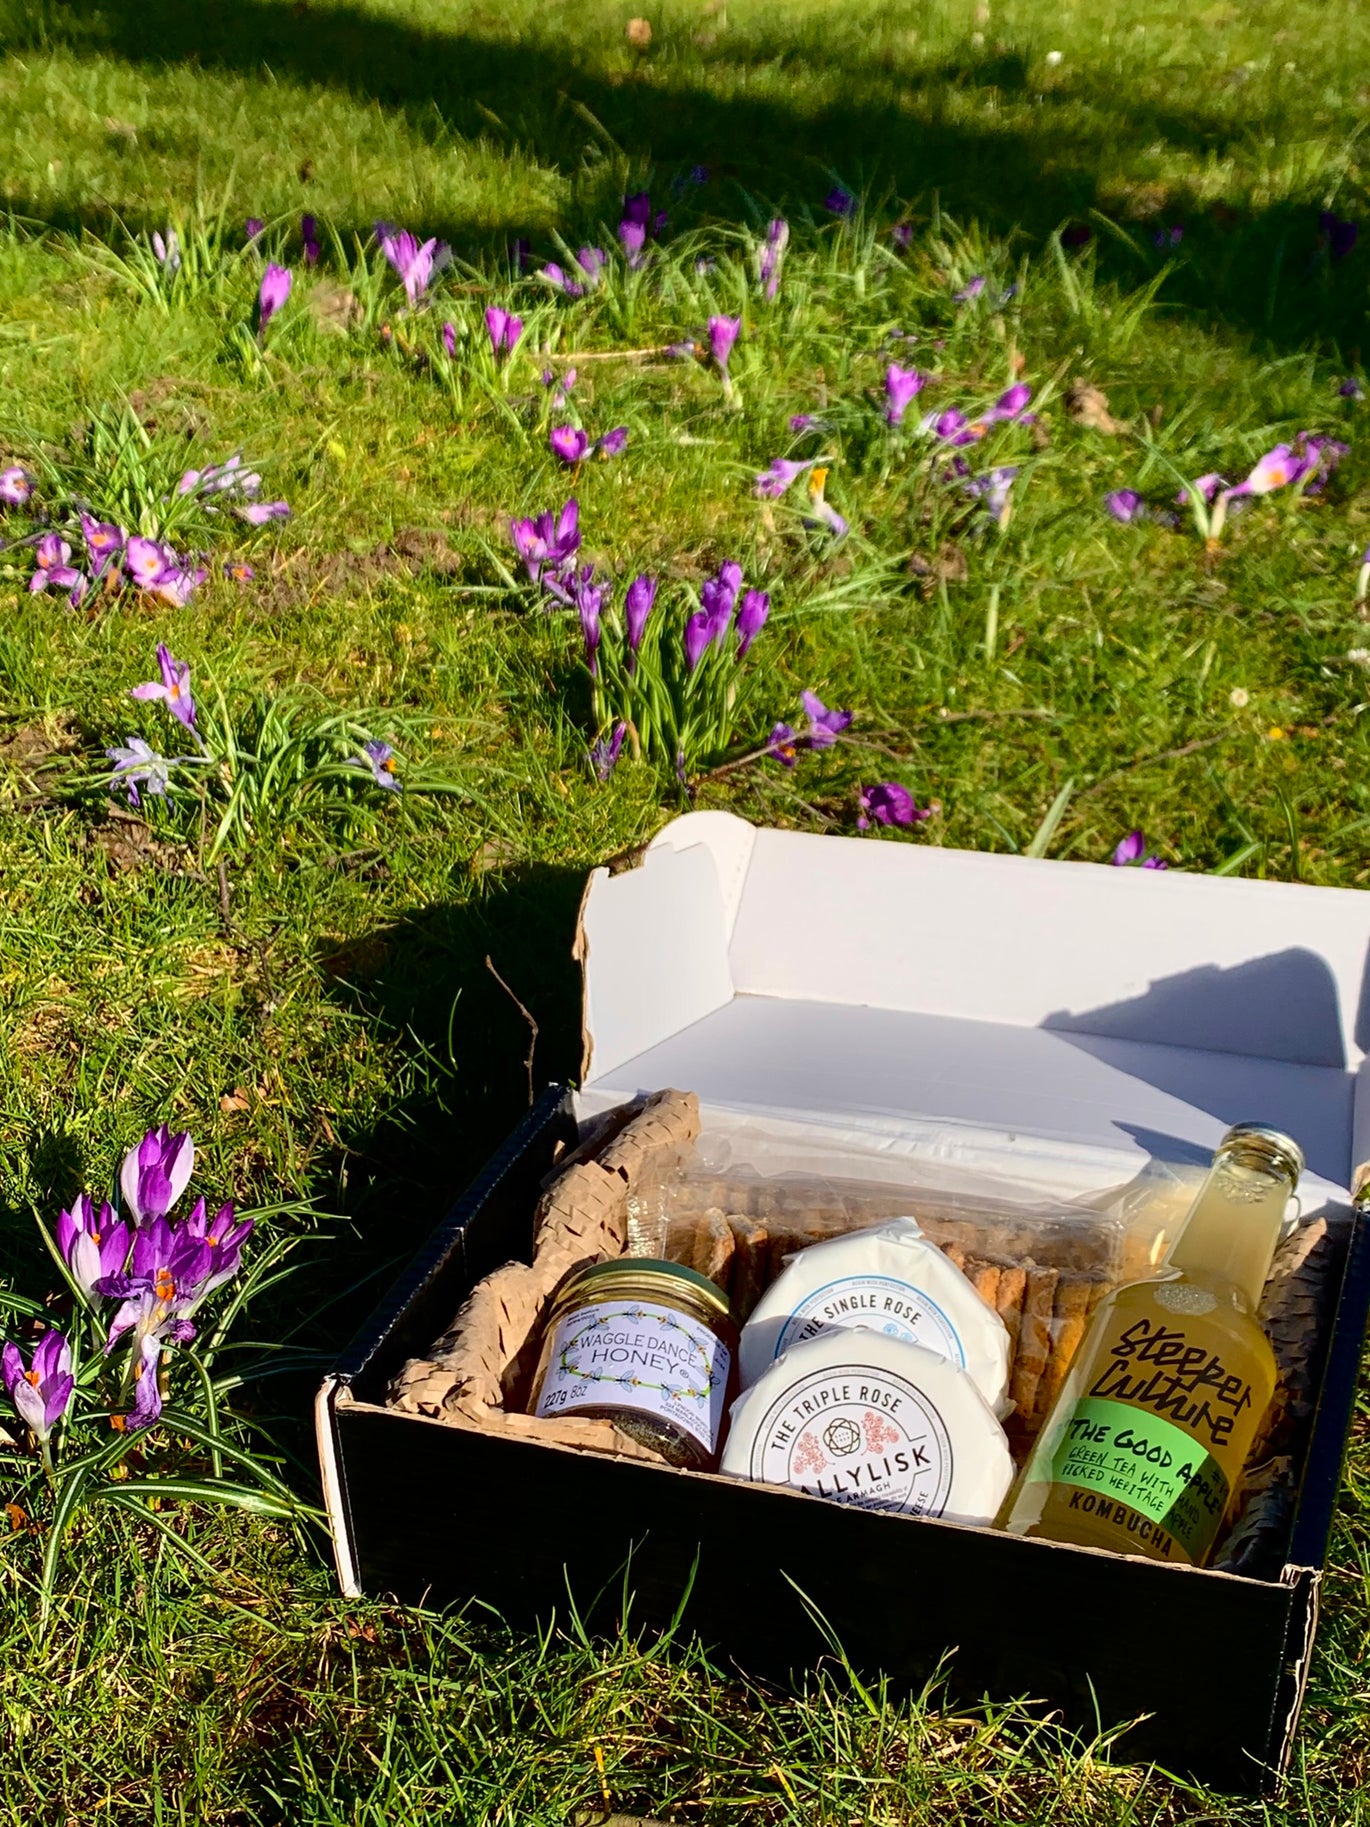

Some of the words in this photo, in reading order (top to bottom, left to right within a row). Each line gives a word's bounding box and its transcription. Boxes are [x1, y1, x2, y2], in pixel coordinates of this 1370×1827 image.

[798, 1316, 824, 1342] THE
[824, 1294, 877, 1319] SINGLE
[884, 1297, 922, 1325] ROSE
[580, 1332, 645, 1349] WAGGLE
[647, 1336, 698, 1369] DANCE
[543, 1389, 569, 1409] 227g
[771, 1420, 797, 1450] THE
[792, 1385, 851, 1420] TRIPLE
[859, 1386, 903, 1413] ROSE
[1089, 1359, 1235, 1447] Culture
[800, 1445, 931, 1499] ALLYLISK
[1068, 1445, 1109, 1467] GREEN
[1113, 1457, 1137, 1479] TEA
[1140, 1471, 1175, 1498] WITH
[1114, 1429, 1172, 1468] GOOD
[1108, 1475, 1165, 1512] HERITAGE
[1068, 1491, 1173, 1557] KOMBUCHA
